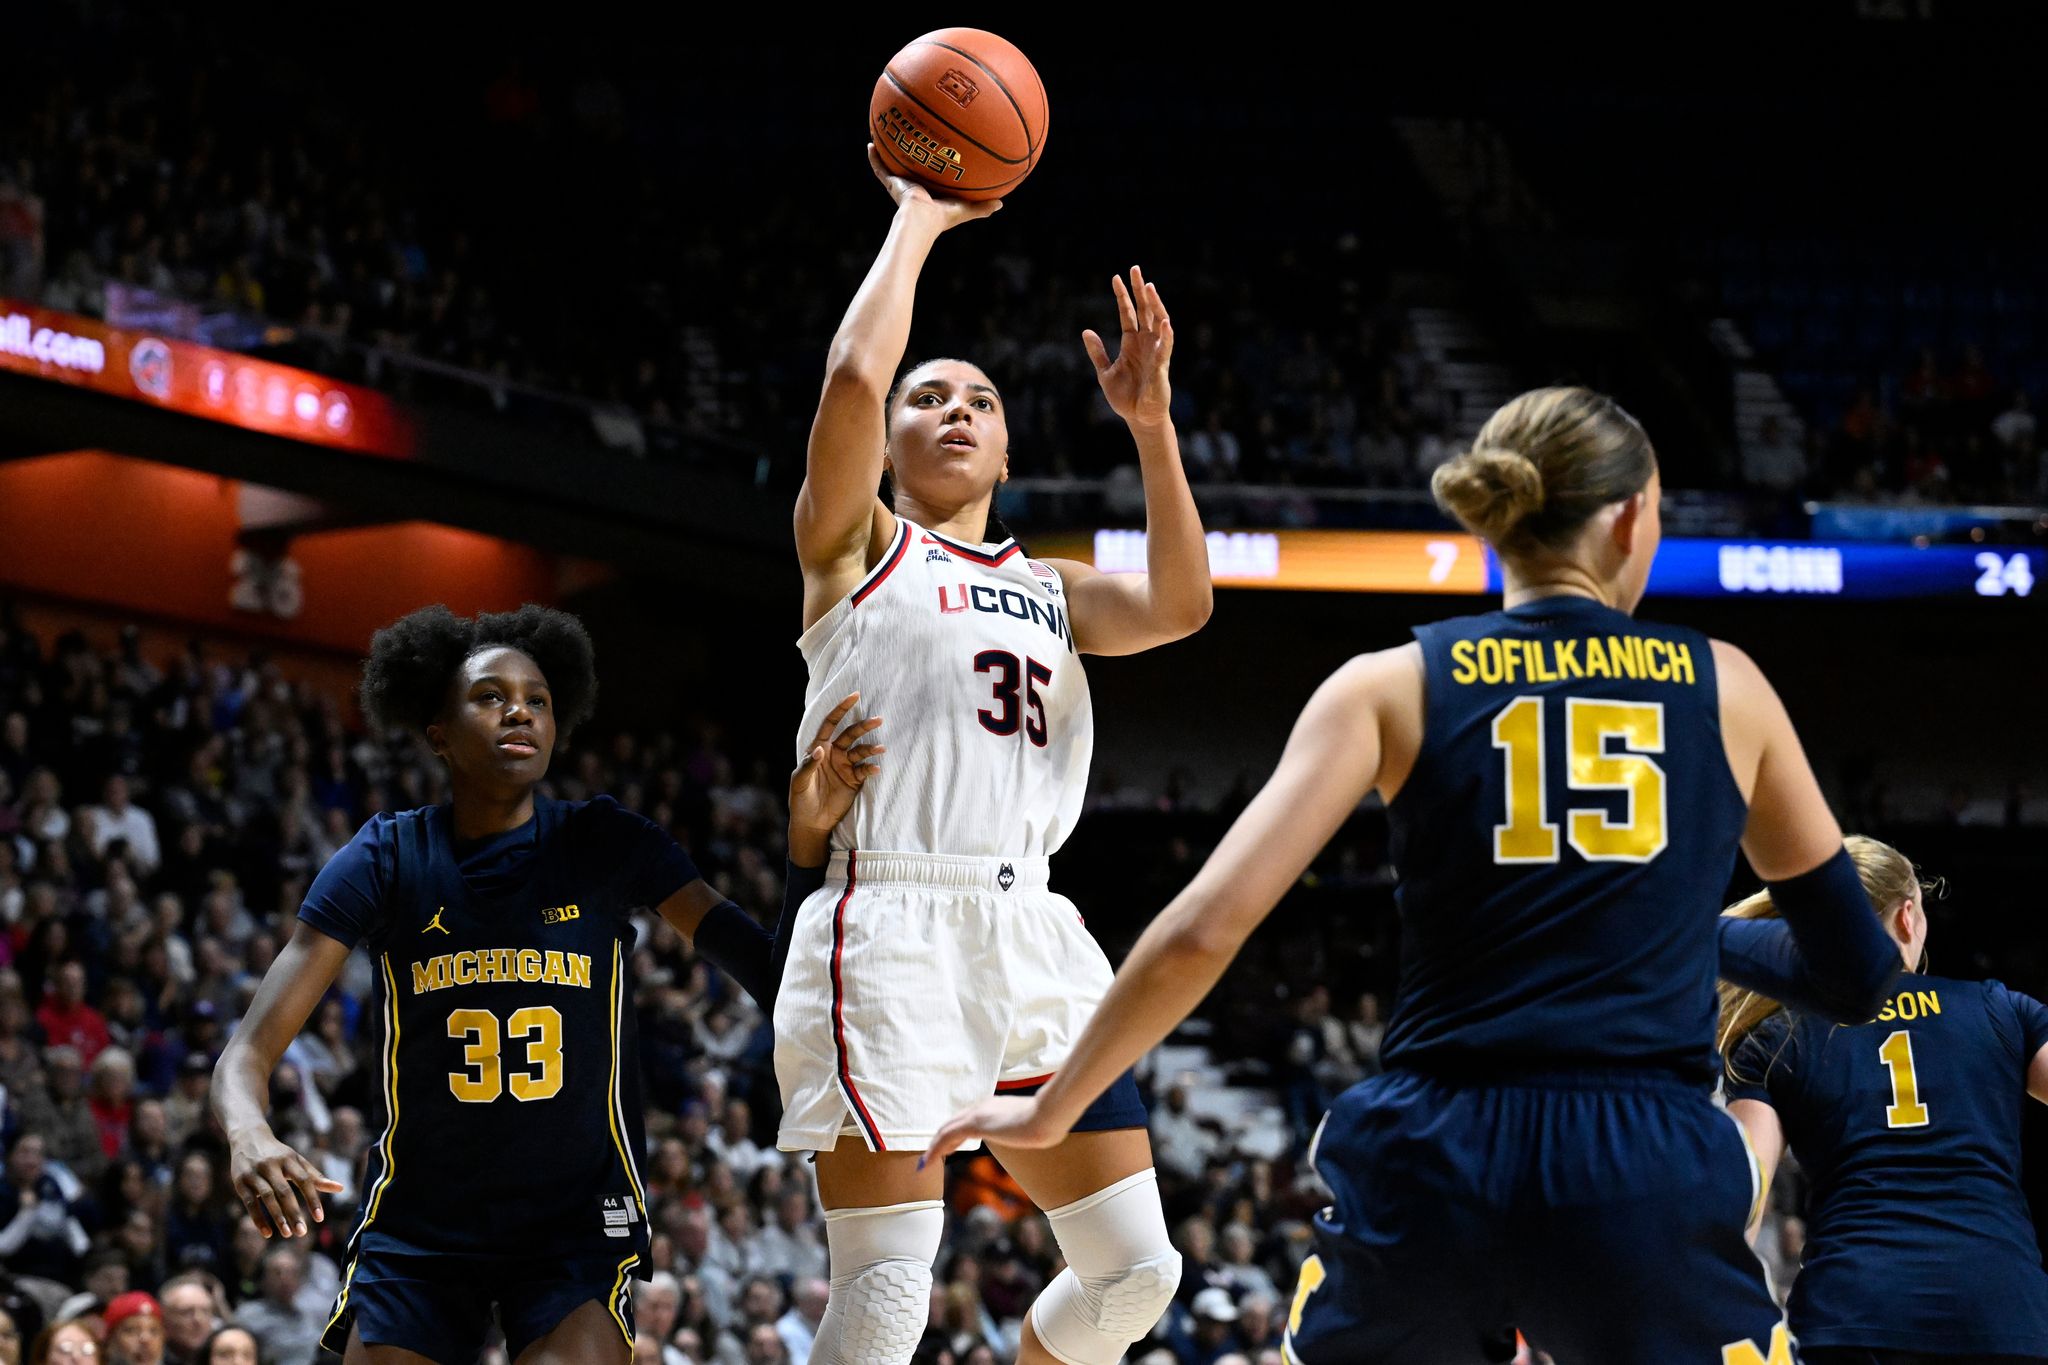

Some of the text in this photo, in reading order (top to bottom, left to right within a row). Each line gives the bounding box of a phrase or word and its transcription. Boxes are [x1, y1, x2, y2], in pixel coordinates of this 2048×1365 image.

[877, 110, 965, 181] LEGACY
[1425, 541, 1459, 583] 7
[1975, 552, 2034, 596] 24
[938, 583, 1073, 654] UCONN
[1450, 635, 1695, 685] SOFILKANICH
[973, 649, 1053, 747] 35
[1491, 695, 1667, 864] 15
[411, 949, 592, 994] MICHIGAN
[447, 1005, 563, 1103] 33
[1878, 1029, 1930, 1129] 1
[604, 1198, 617, 1208] 44
